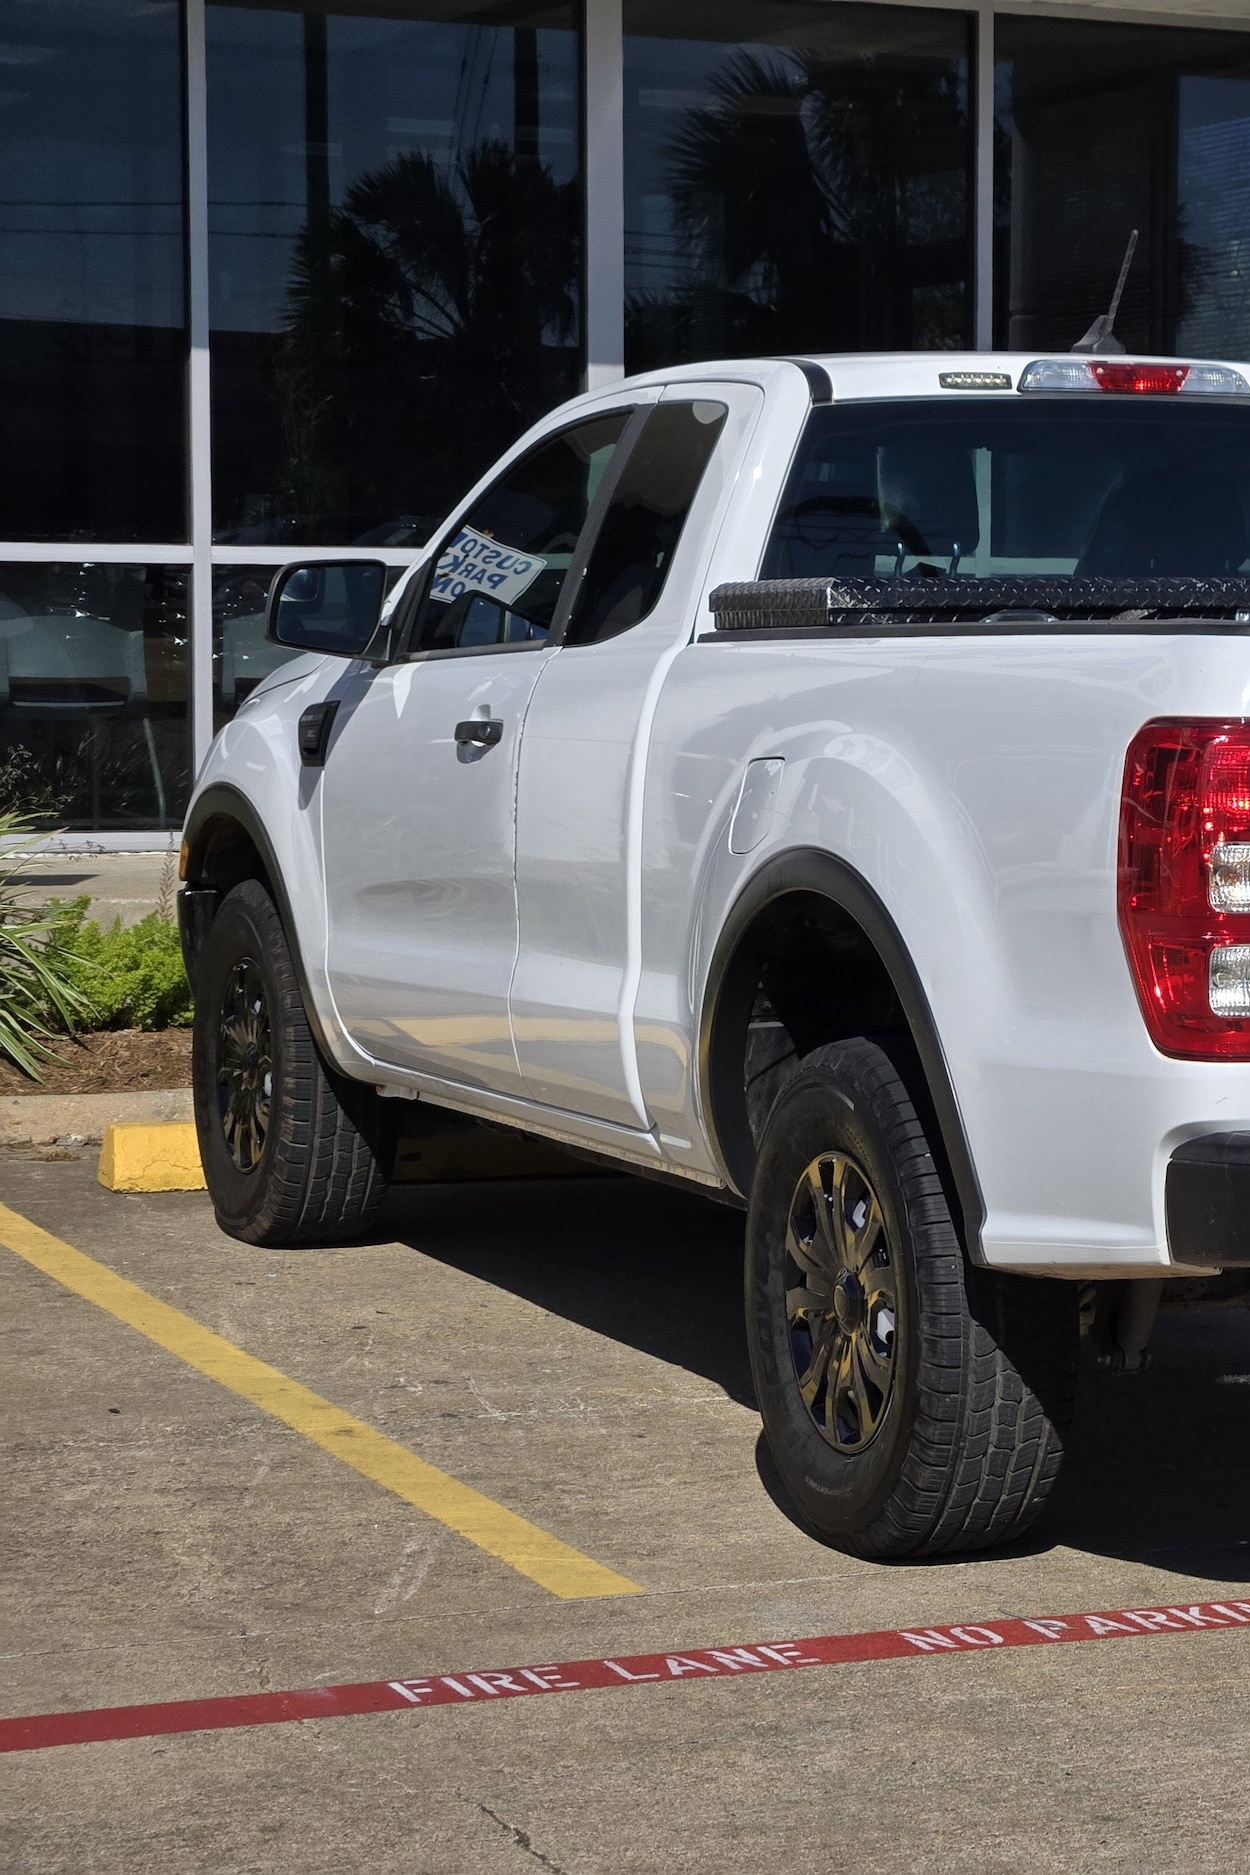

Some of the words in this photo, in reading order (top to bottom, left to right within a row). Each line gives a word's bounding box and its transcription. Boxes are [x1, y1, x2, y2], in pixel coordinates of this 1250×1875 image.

[388, 1666, 580, 1703] FIRE
[604, 1643, 821, 1681] LANE
[900, 1626, 1005, 1651] NO
